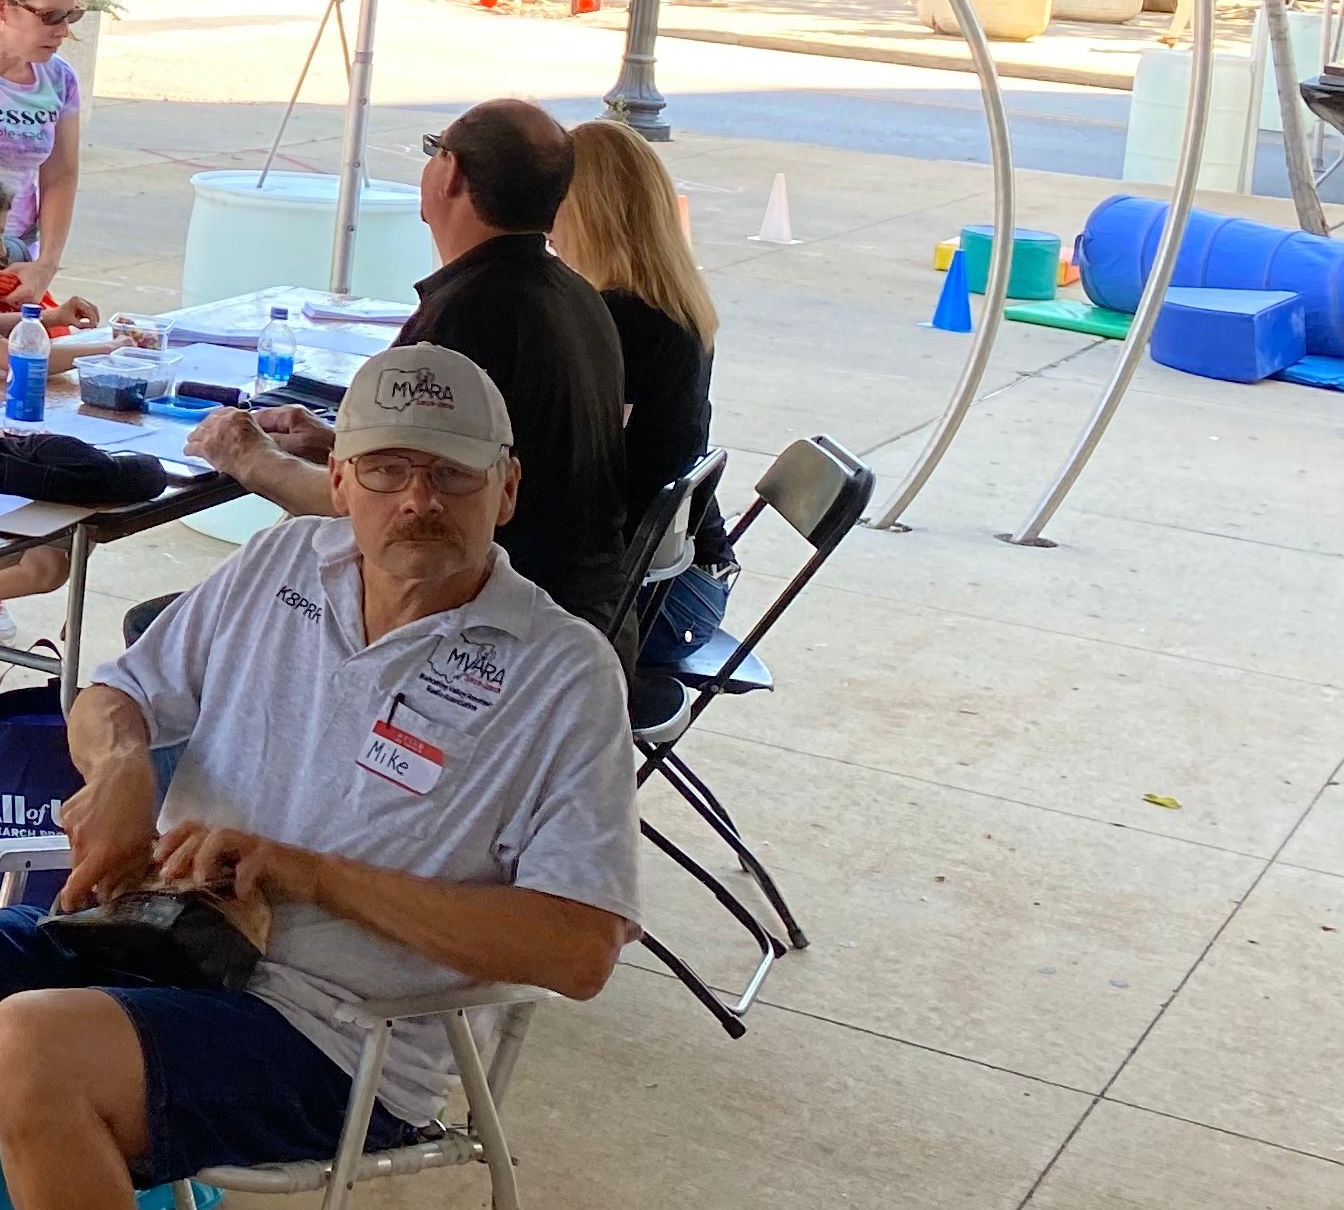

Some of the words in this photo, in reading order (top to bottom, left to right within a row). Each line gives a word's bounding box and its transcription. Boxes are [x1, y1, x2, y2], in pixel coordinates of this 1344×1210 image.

[392, 373, 454, 402] MVARA
[447, 647, 505, 687] MVARA
[366, 740, 409, 776] Mike
[26, 803, 50, 826] of
